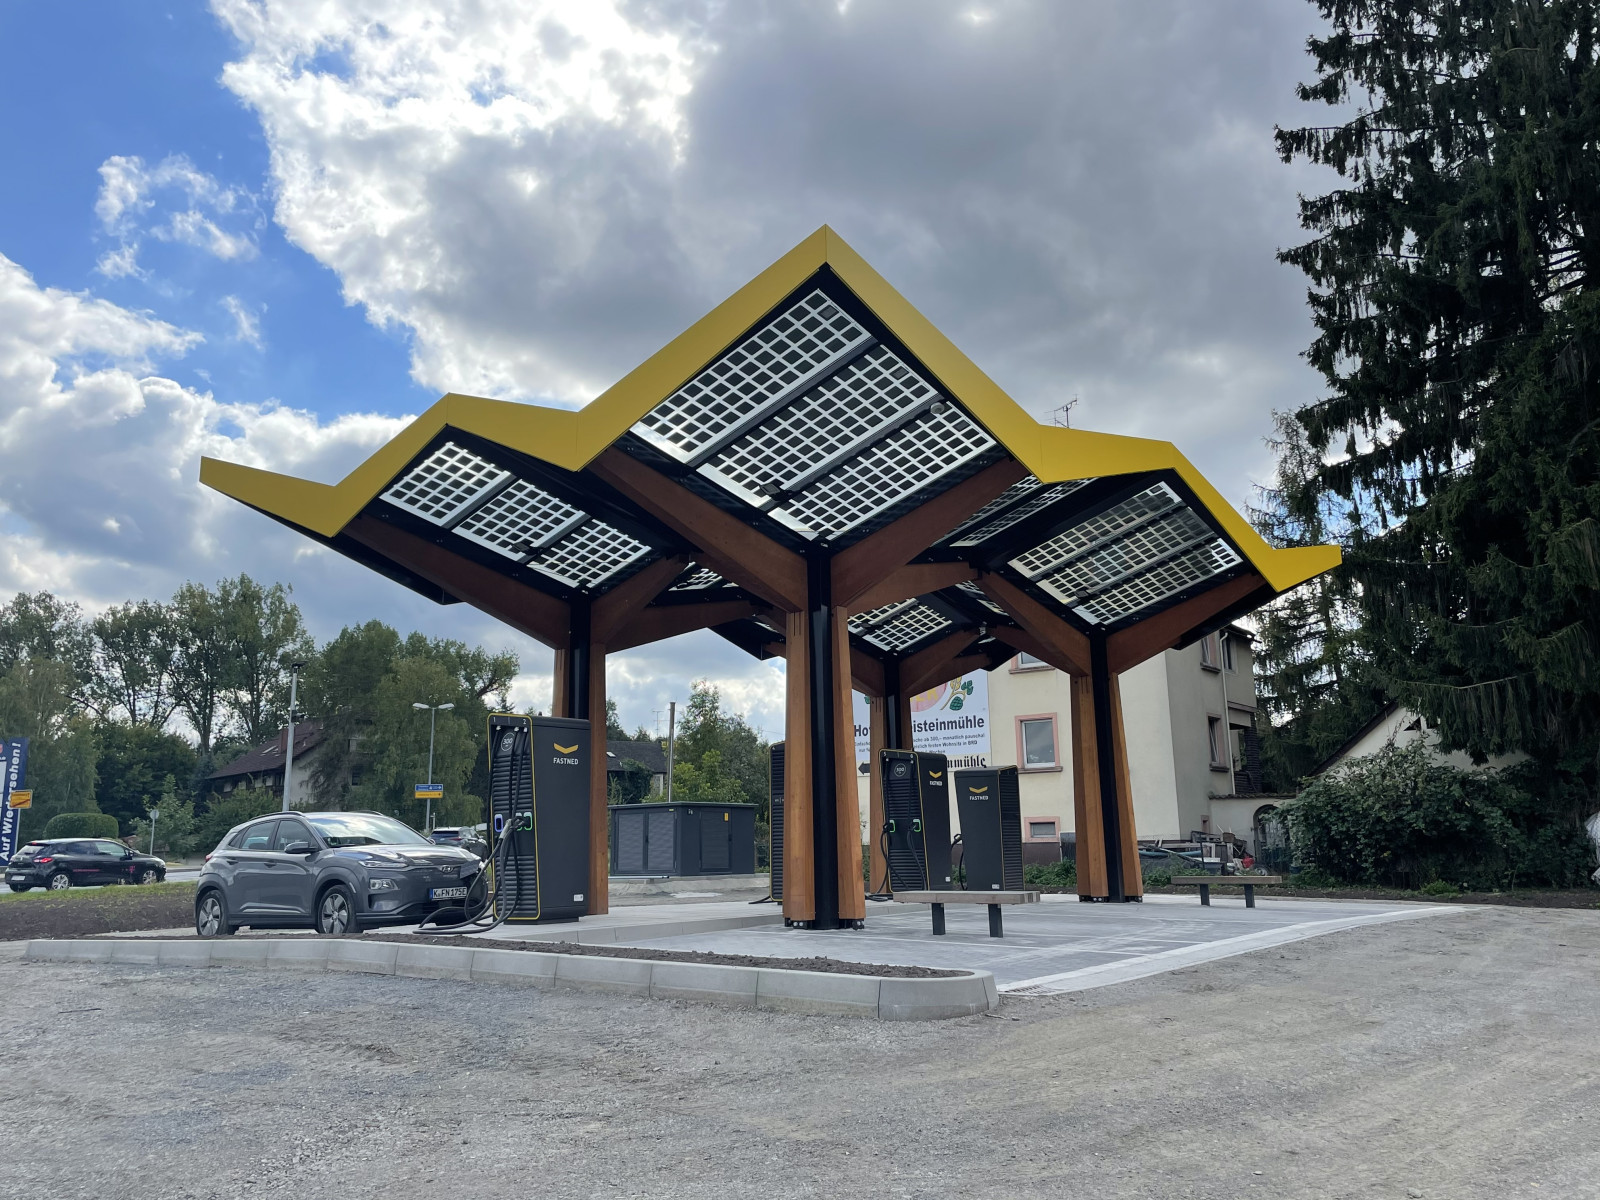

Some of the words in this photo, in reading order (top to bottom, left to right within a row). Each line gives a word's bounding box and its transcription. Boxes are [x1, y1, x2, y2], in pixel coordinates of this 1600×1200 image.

[913, 714, 985, 733] isteinmühle
[553, 757, 579, 765] FASTNED
[947, 754, 988, 768] nmühle
[2, 742, 21, 835] Wiedrsehen!
[0, 837, 11, 862] Auf
